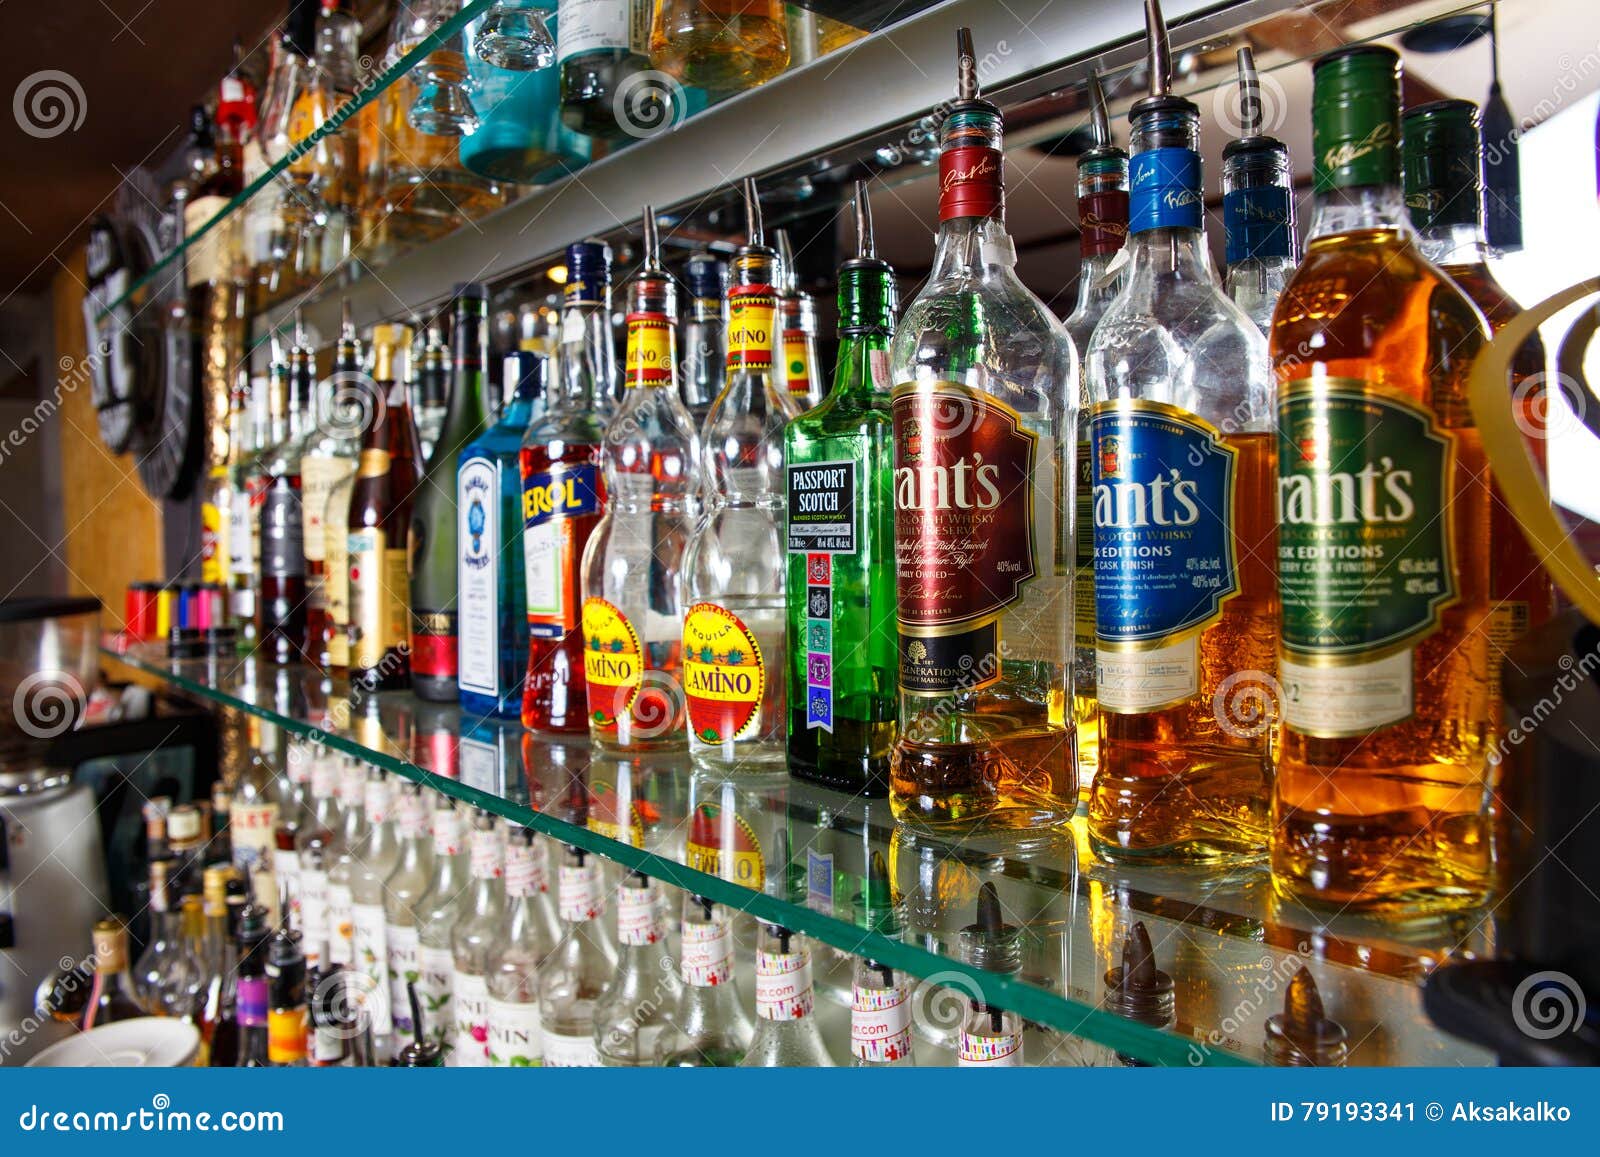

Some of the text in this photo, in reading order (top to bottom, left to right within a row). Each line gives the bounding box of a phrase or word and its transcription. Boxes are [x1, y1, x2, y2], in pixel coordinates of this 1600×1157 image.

[793, 469, 846, 490] PASSPORT
[521, 476, 583, 520] EROL
[799, 492, 839, 512] SCOTCH
[1093, 467, 1200, 528] ant's
[901, 513, 995, 524] SCOTH WHISKY
[925, 526, 977, 536] ESERVE
[1147, 530, 1194, 542] WHISKY
[1102, 546, 1172, 558] EDITIONS
[1297, 545, 1385, 559] EDITIONS
[1121, 560, 1154, 570] FINISH
[920, 676, 949, 684] MAKING
